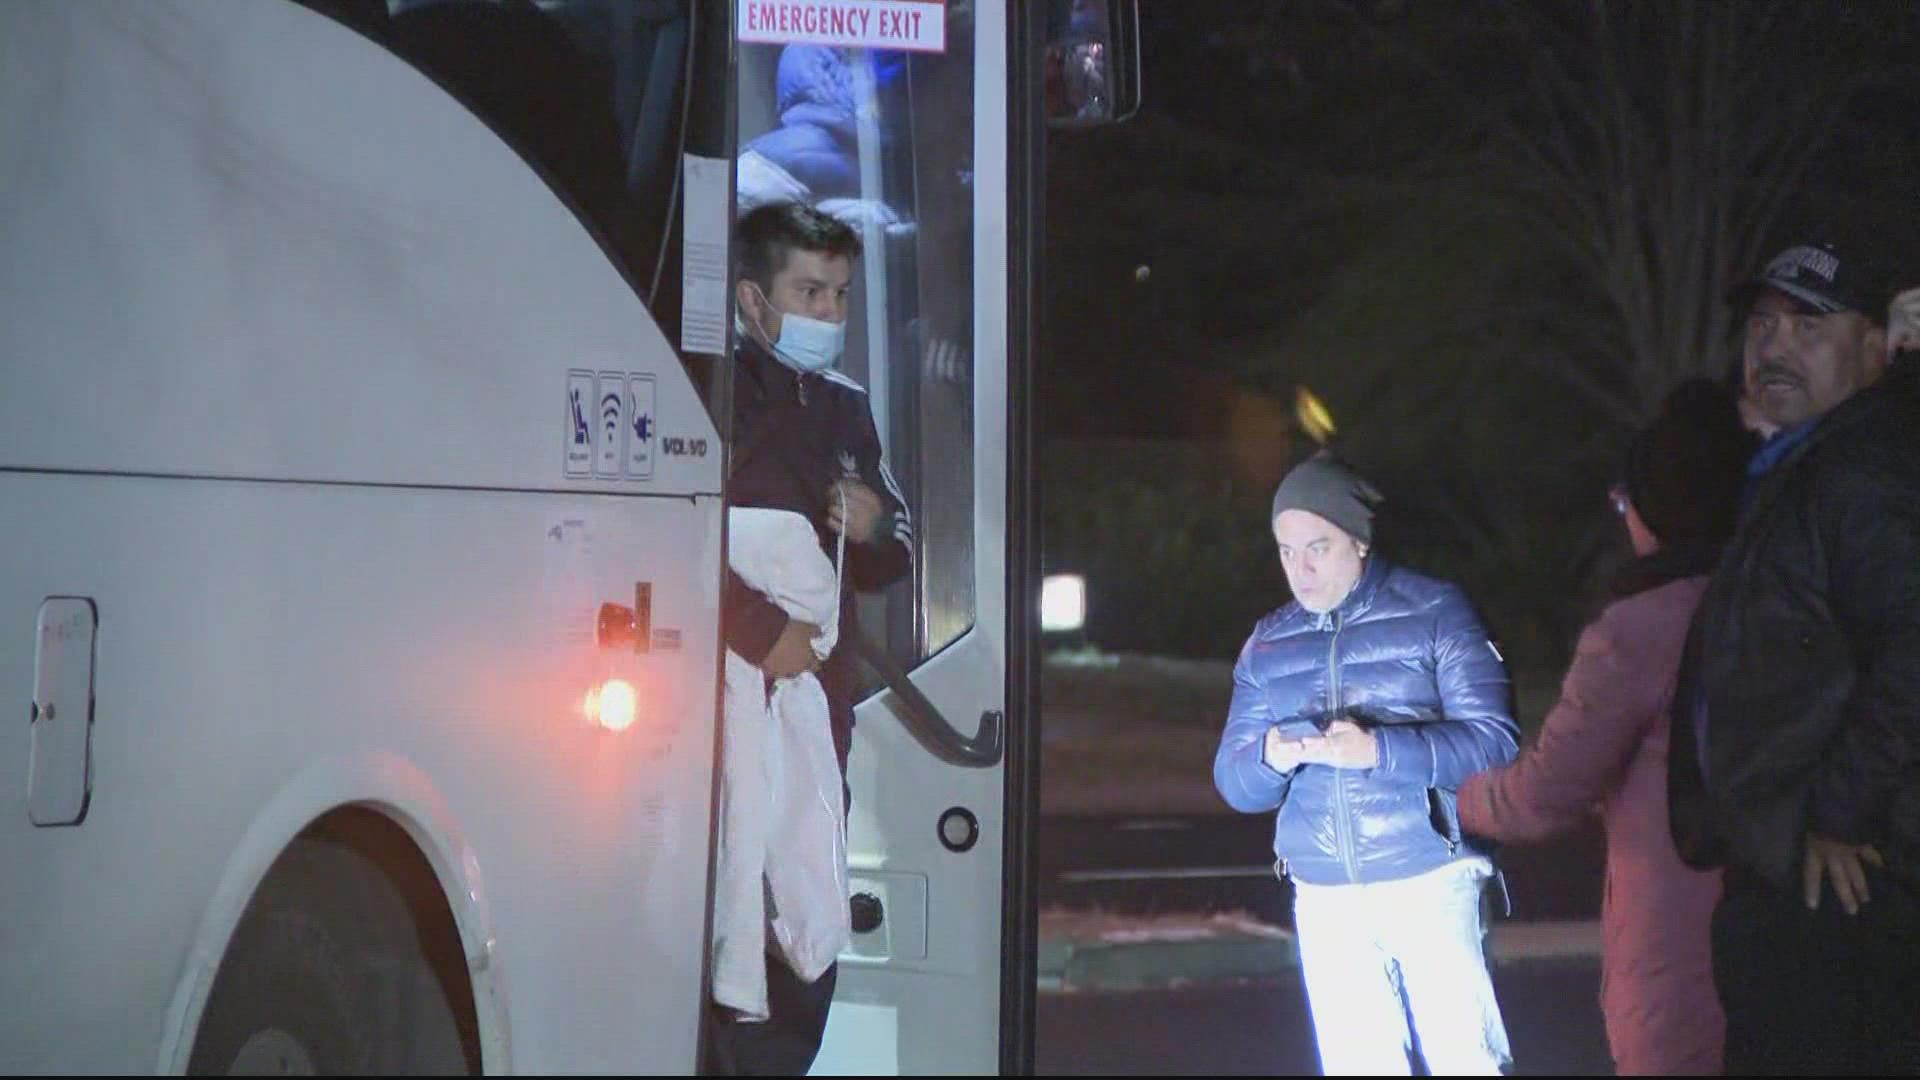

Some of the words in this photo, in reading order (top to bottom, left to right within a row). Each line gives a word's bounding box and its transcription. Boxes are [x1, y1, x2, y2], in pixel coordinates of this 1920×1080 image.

[747, 3, 870, 36] EMERGENCY
[879, 10, 921, 39] EXIT
[662, 437, 707, 457] VOLVO
